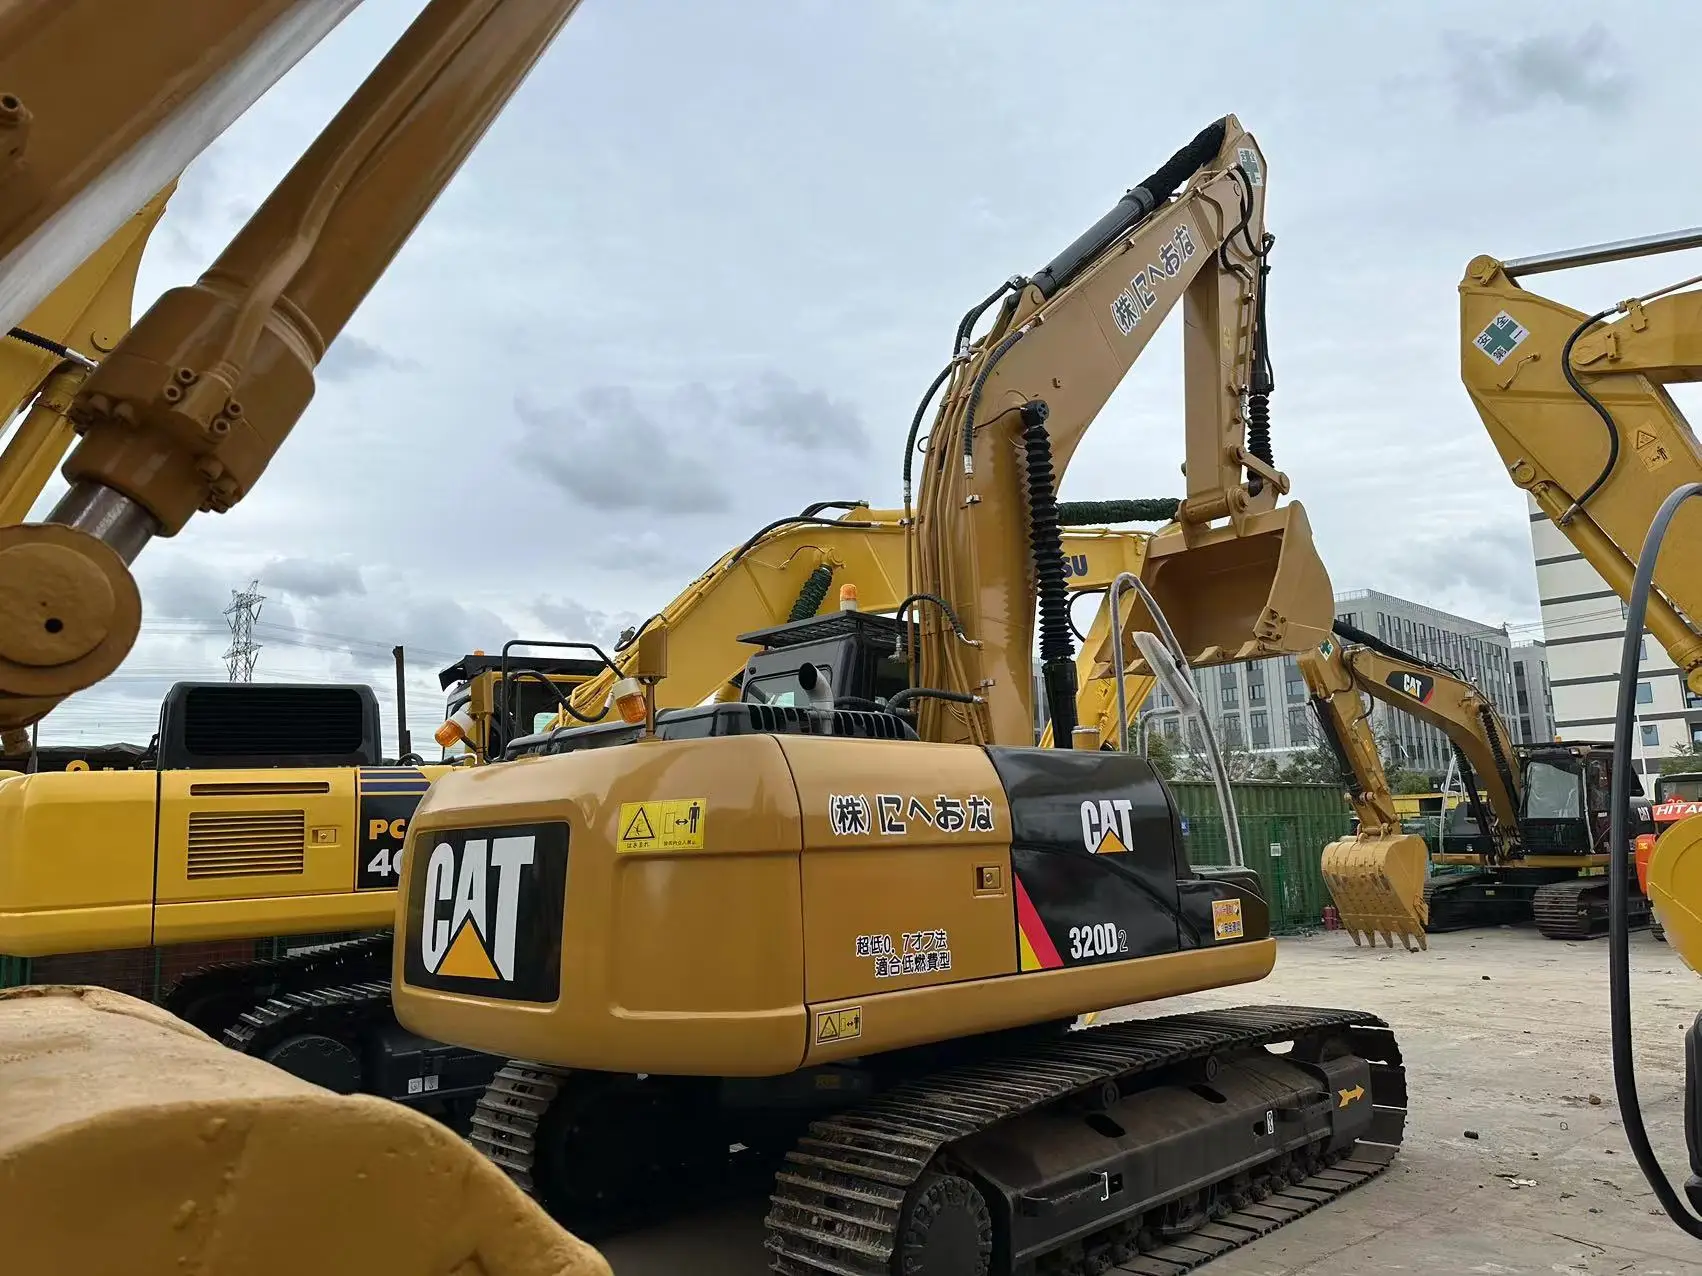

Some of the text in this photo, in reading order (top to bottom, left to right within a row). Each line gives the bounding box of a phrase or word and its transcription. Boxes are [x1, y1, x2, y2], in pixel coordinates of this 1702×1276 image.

[1403, 673, 1422, 698] CAT
[1656, 804, 1702, 815] HITA
[369, 819, 405, 840] PC
[1081, 799, 1133, 855] CAT
[421, 836, 536, 982] CAT
